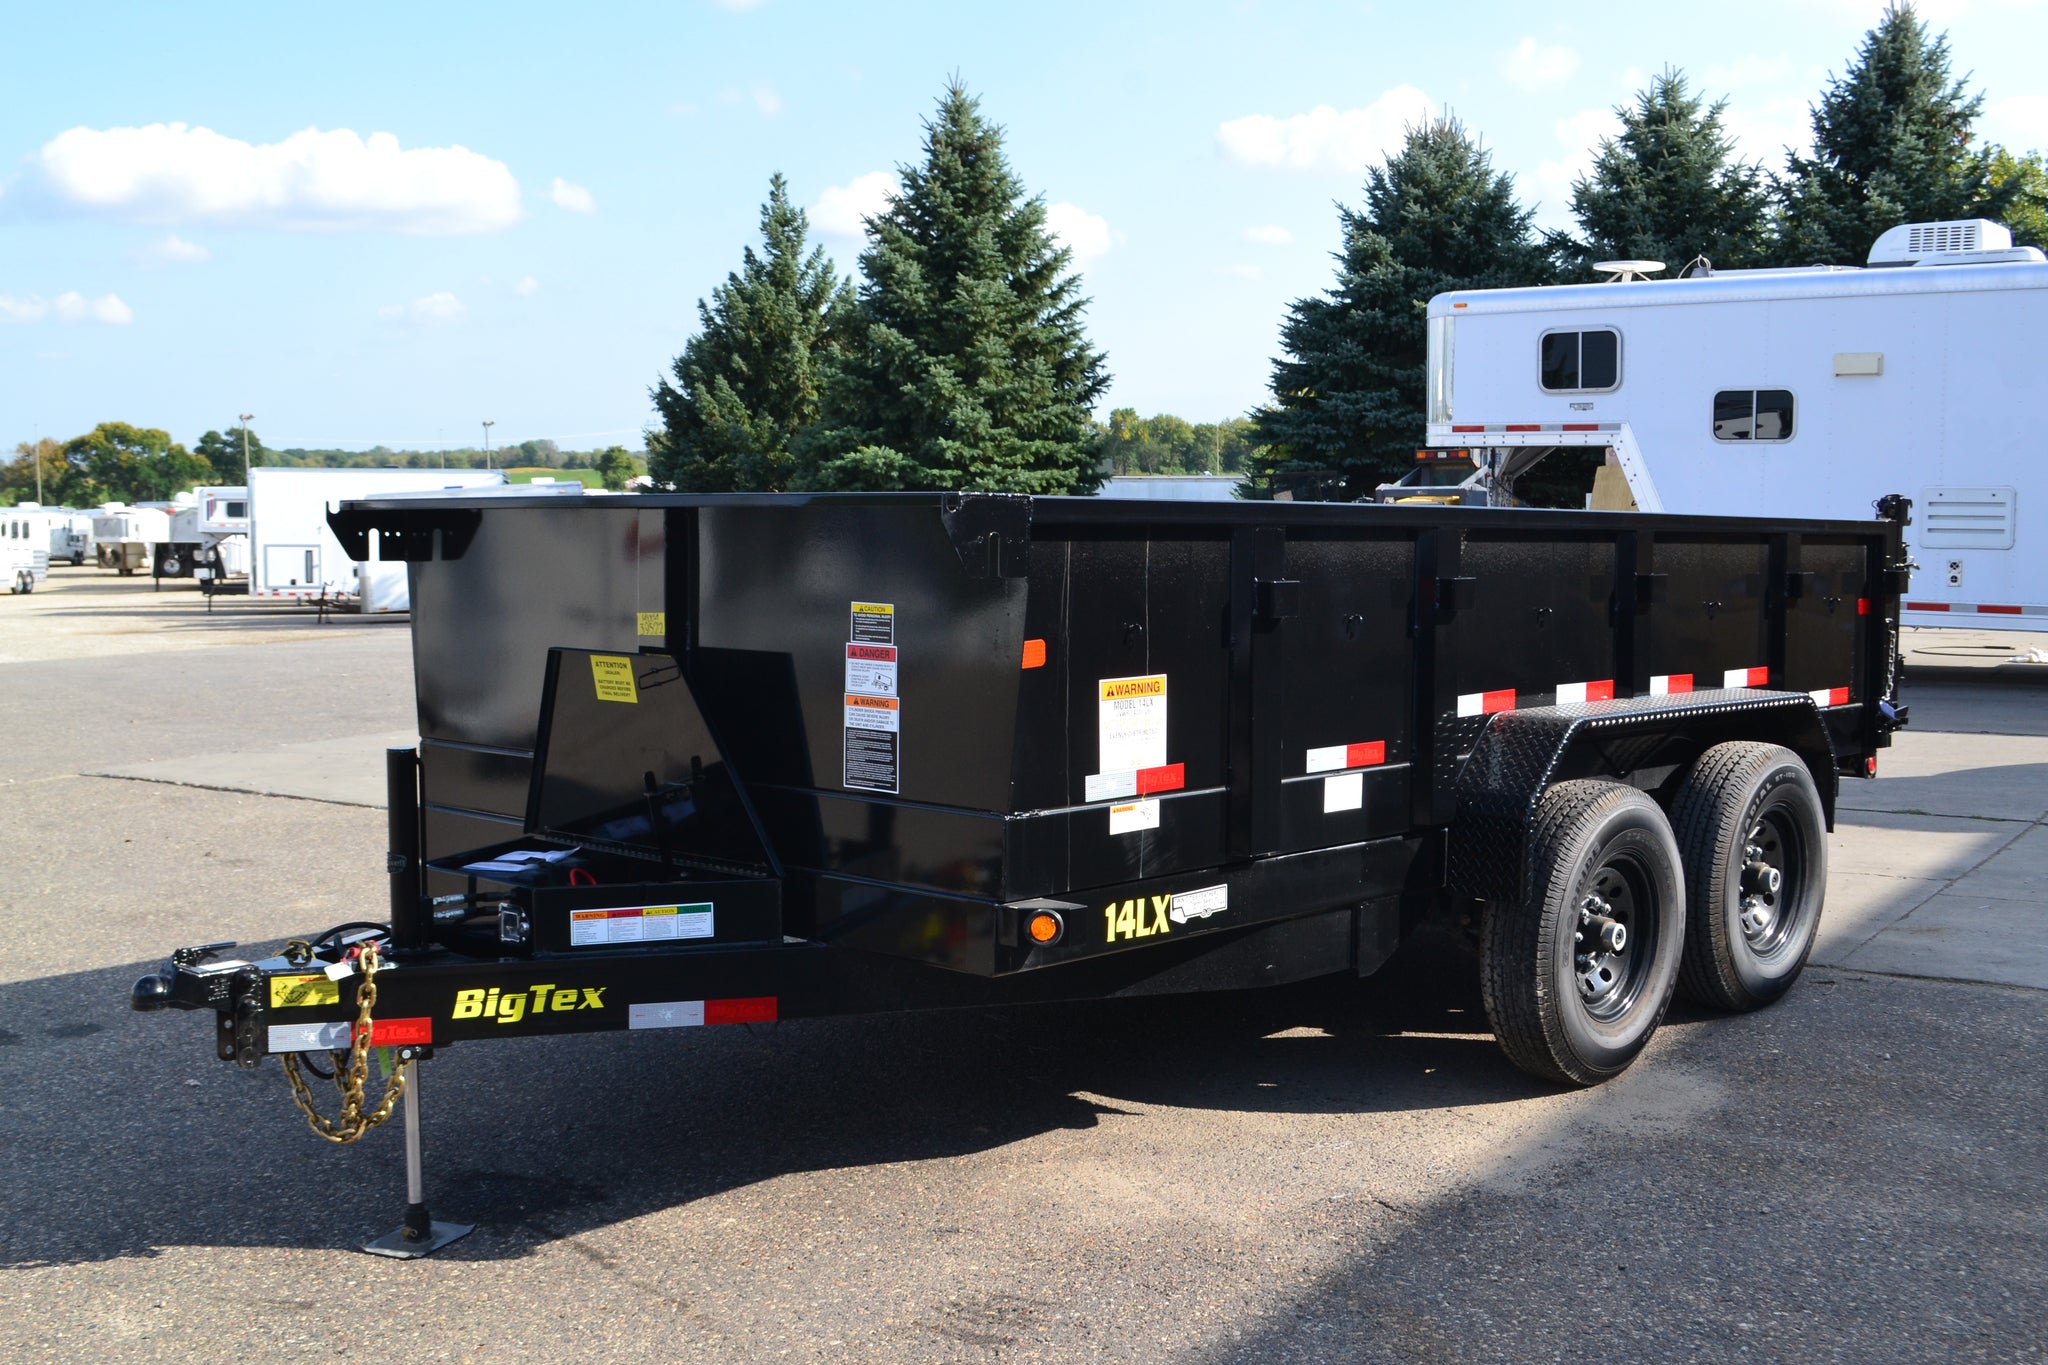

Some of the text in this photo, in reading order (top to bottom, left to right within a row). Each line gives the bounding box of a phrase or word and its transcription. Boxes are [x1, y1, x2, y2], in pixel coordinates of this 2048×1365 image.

[864, 605, 886, 613] CAUTION
[859, 648, 890, 659] DANGER
[595, 661, 628, 670] ATTENTION
[1115, 681, 1161, 696] WARNING
[860, 698, 890, 708] WARNING
[1113, 699, 1136, 710] MODEL
[1740, 782, 1772, 845] RADIAL
[1562, 841, 1601, 968] GOODRIDE
[575, 912, 606, 920] WARNING
[1105, 894, 1171, 942] 14LX
[452, 984, 607, 1023] BigTex
